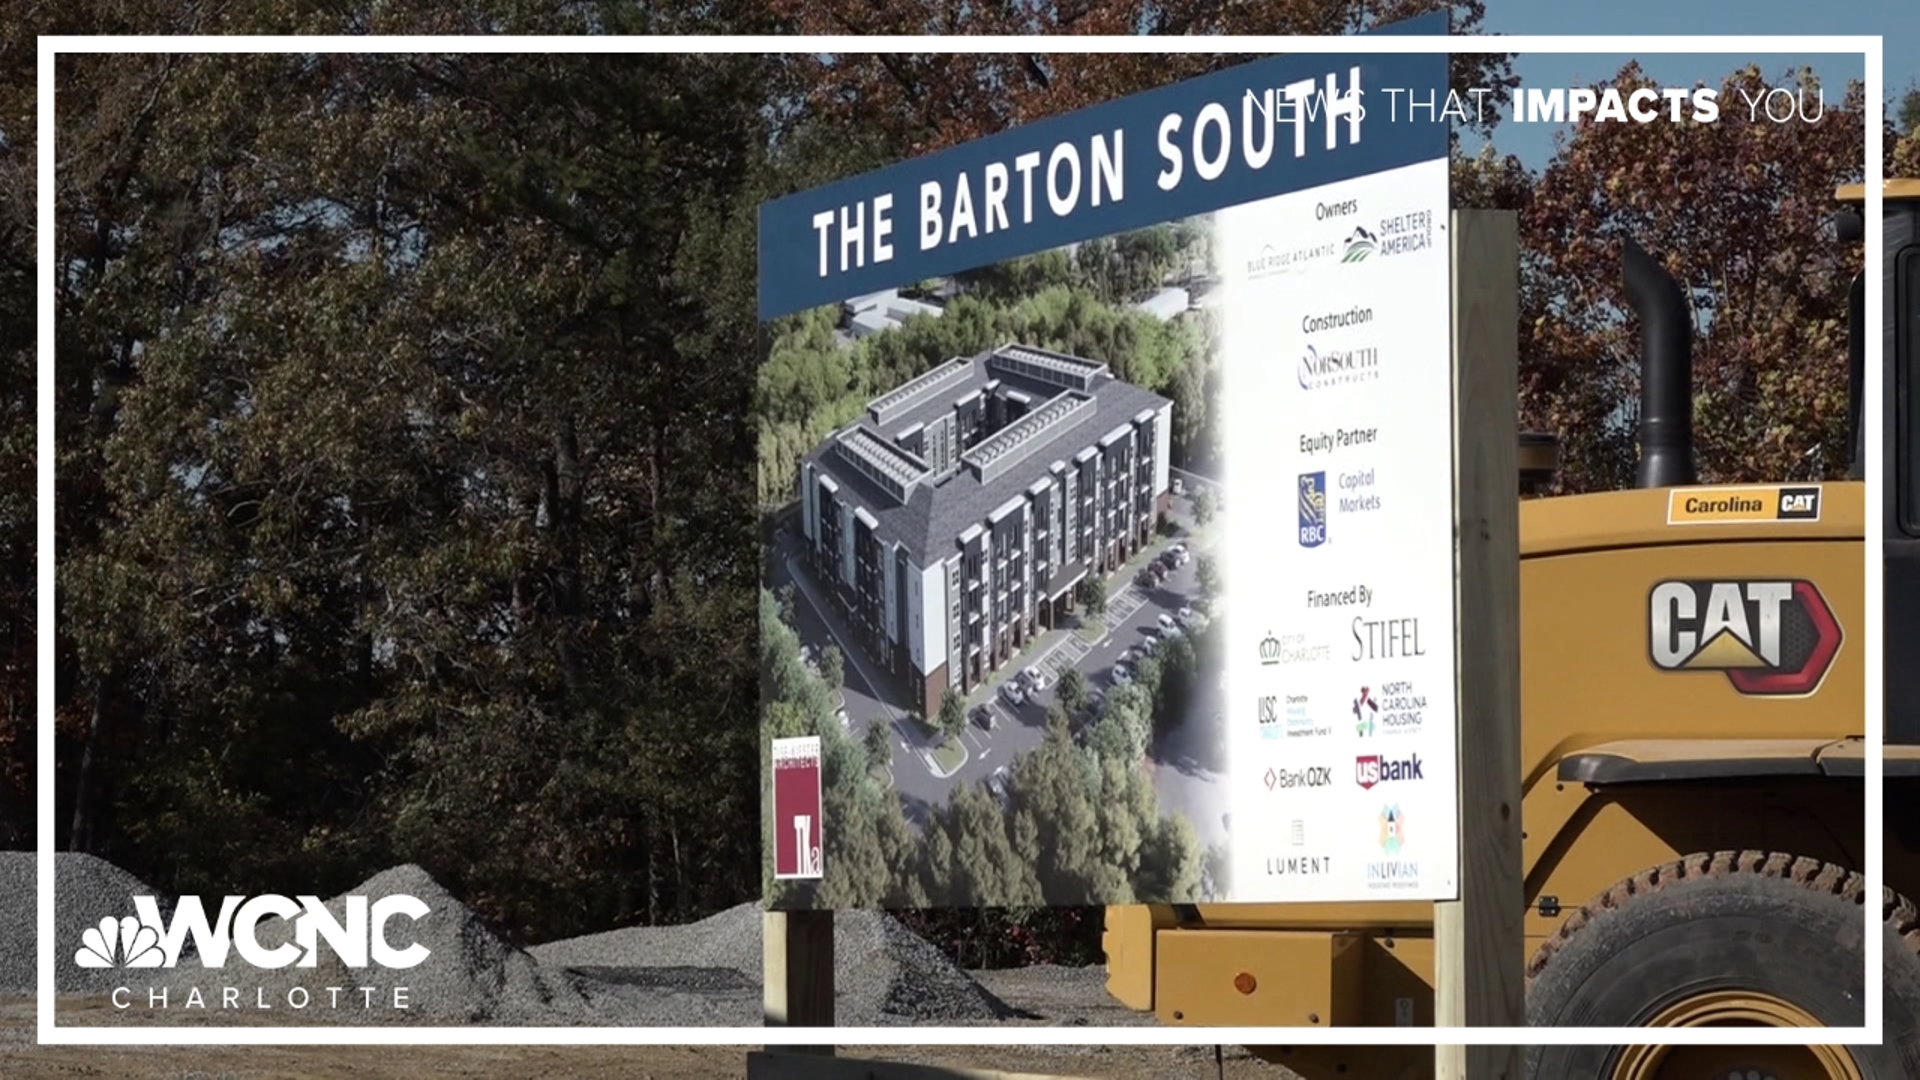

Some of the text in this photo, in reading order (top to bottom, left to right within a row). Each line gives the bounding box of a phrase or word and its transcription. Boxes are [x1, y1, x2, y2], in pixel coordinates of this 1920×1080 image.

[812, 66, 1362, 278] THE BARTON SOUTH
[1316, 199, 1358, 221] Owners
[1380, 211, 1426, 237] SHELTER
[1380, 233, 1426, 256] AMERICA
[1247, 243, 1335, 273] BLUE RIDGE ATLANTIC
[1302, 305, 1373, 334] Construction
[1300, 427, 1377, 456] Equity Partner
[1339, 468, 1375, 492] Capital
[1339, 495, 1381, 513] Markets
[1685, 494, 1815, 513] Carolina CAT
[1300, 524, 1325, 544] RBC
[1307, 585, 1373, 608] Financed By
[1651, 581, 1793, 669] CAT
[1281, 645, 1330, 664] CHARLOTTE
[1382, 681, 1413, 696] NORTH
[1382, 696, 1428, 712] CAROLINA
[1382, 711, 1423, 727] HOUSING
[1267, 857, 1331, 876] LUMENT
